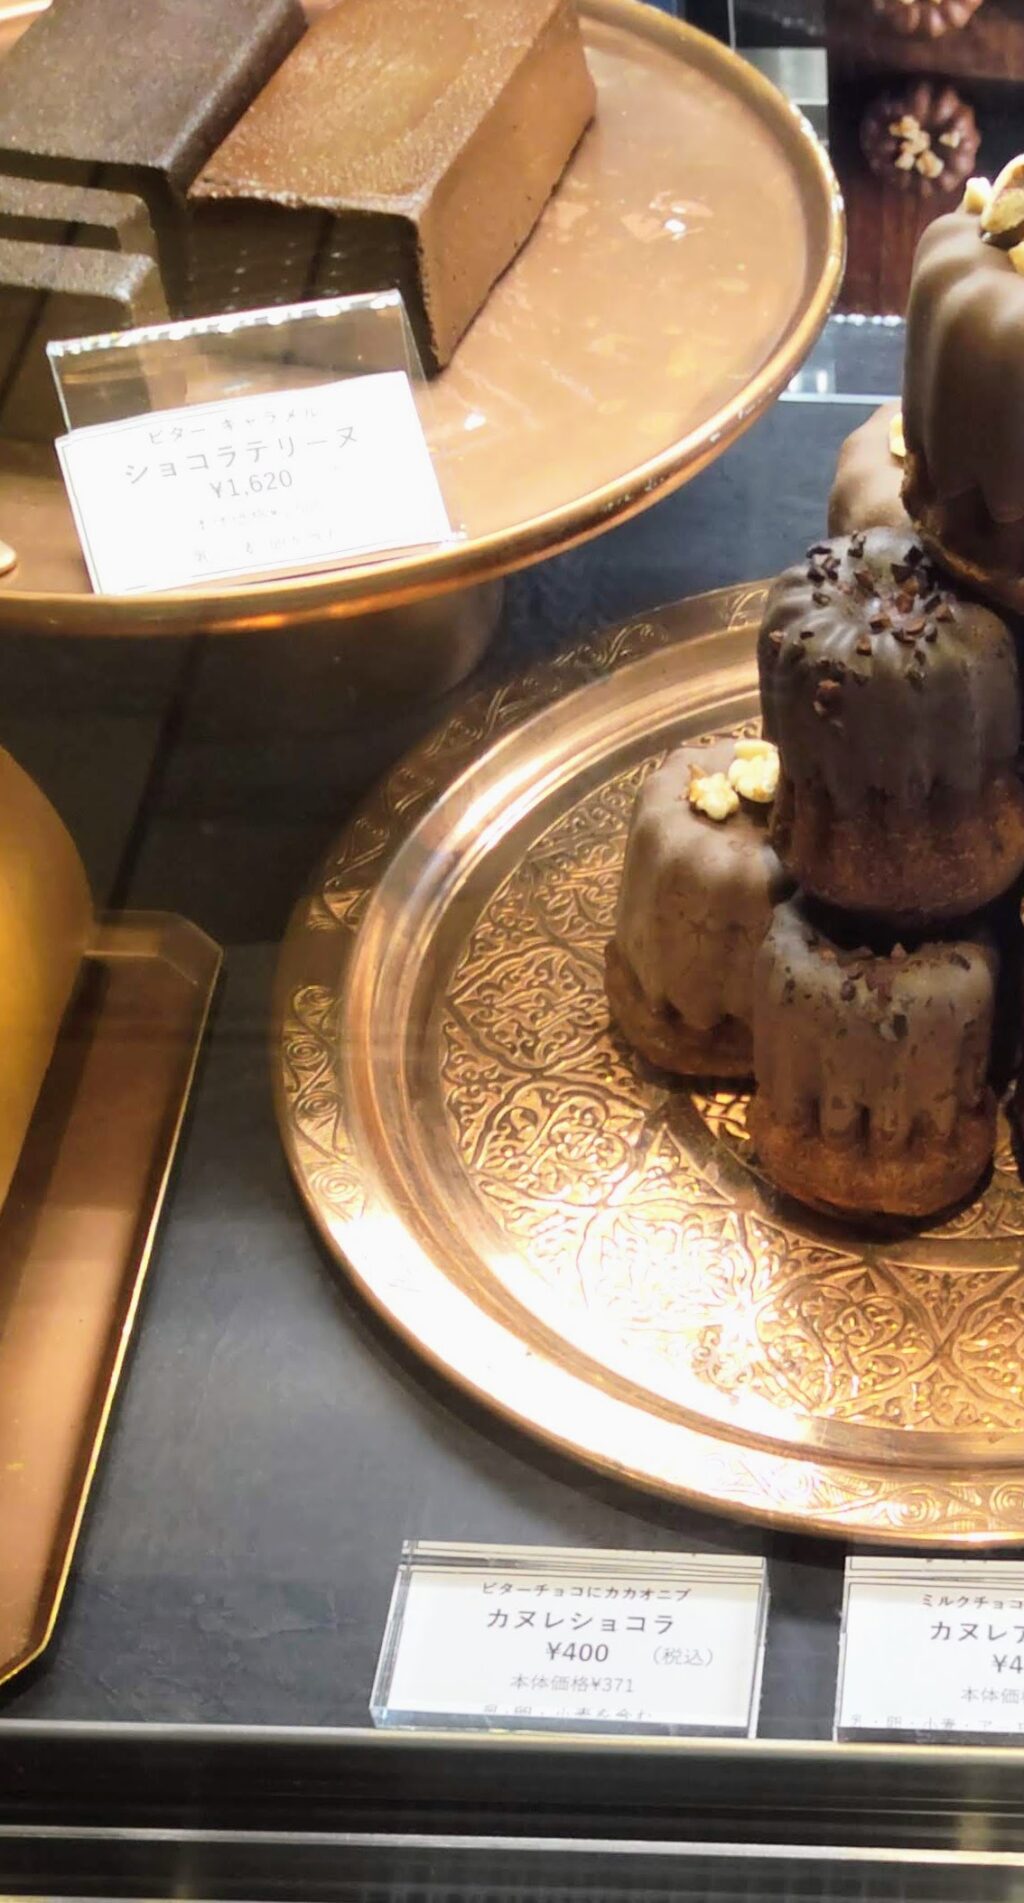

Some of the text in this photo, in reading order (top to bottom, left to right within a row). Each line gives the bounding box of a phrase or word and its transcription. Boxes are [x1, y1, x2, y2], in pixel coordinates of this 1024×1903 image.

[125, 426, 357, 485] ショコラテリーヌ
[209, 469, 293, 498] ¥1,620
[482, 1581, 692, 1603] ビターチョコにカカオニブ
[486, 1608, 675, 1636] カヌレショコラ
[545, 1641, 609, 1663] ¥400
[509, 1674, 635, 1694] 本体価格¥371
